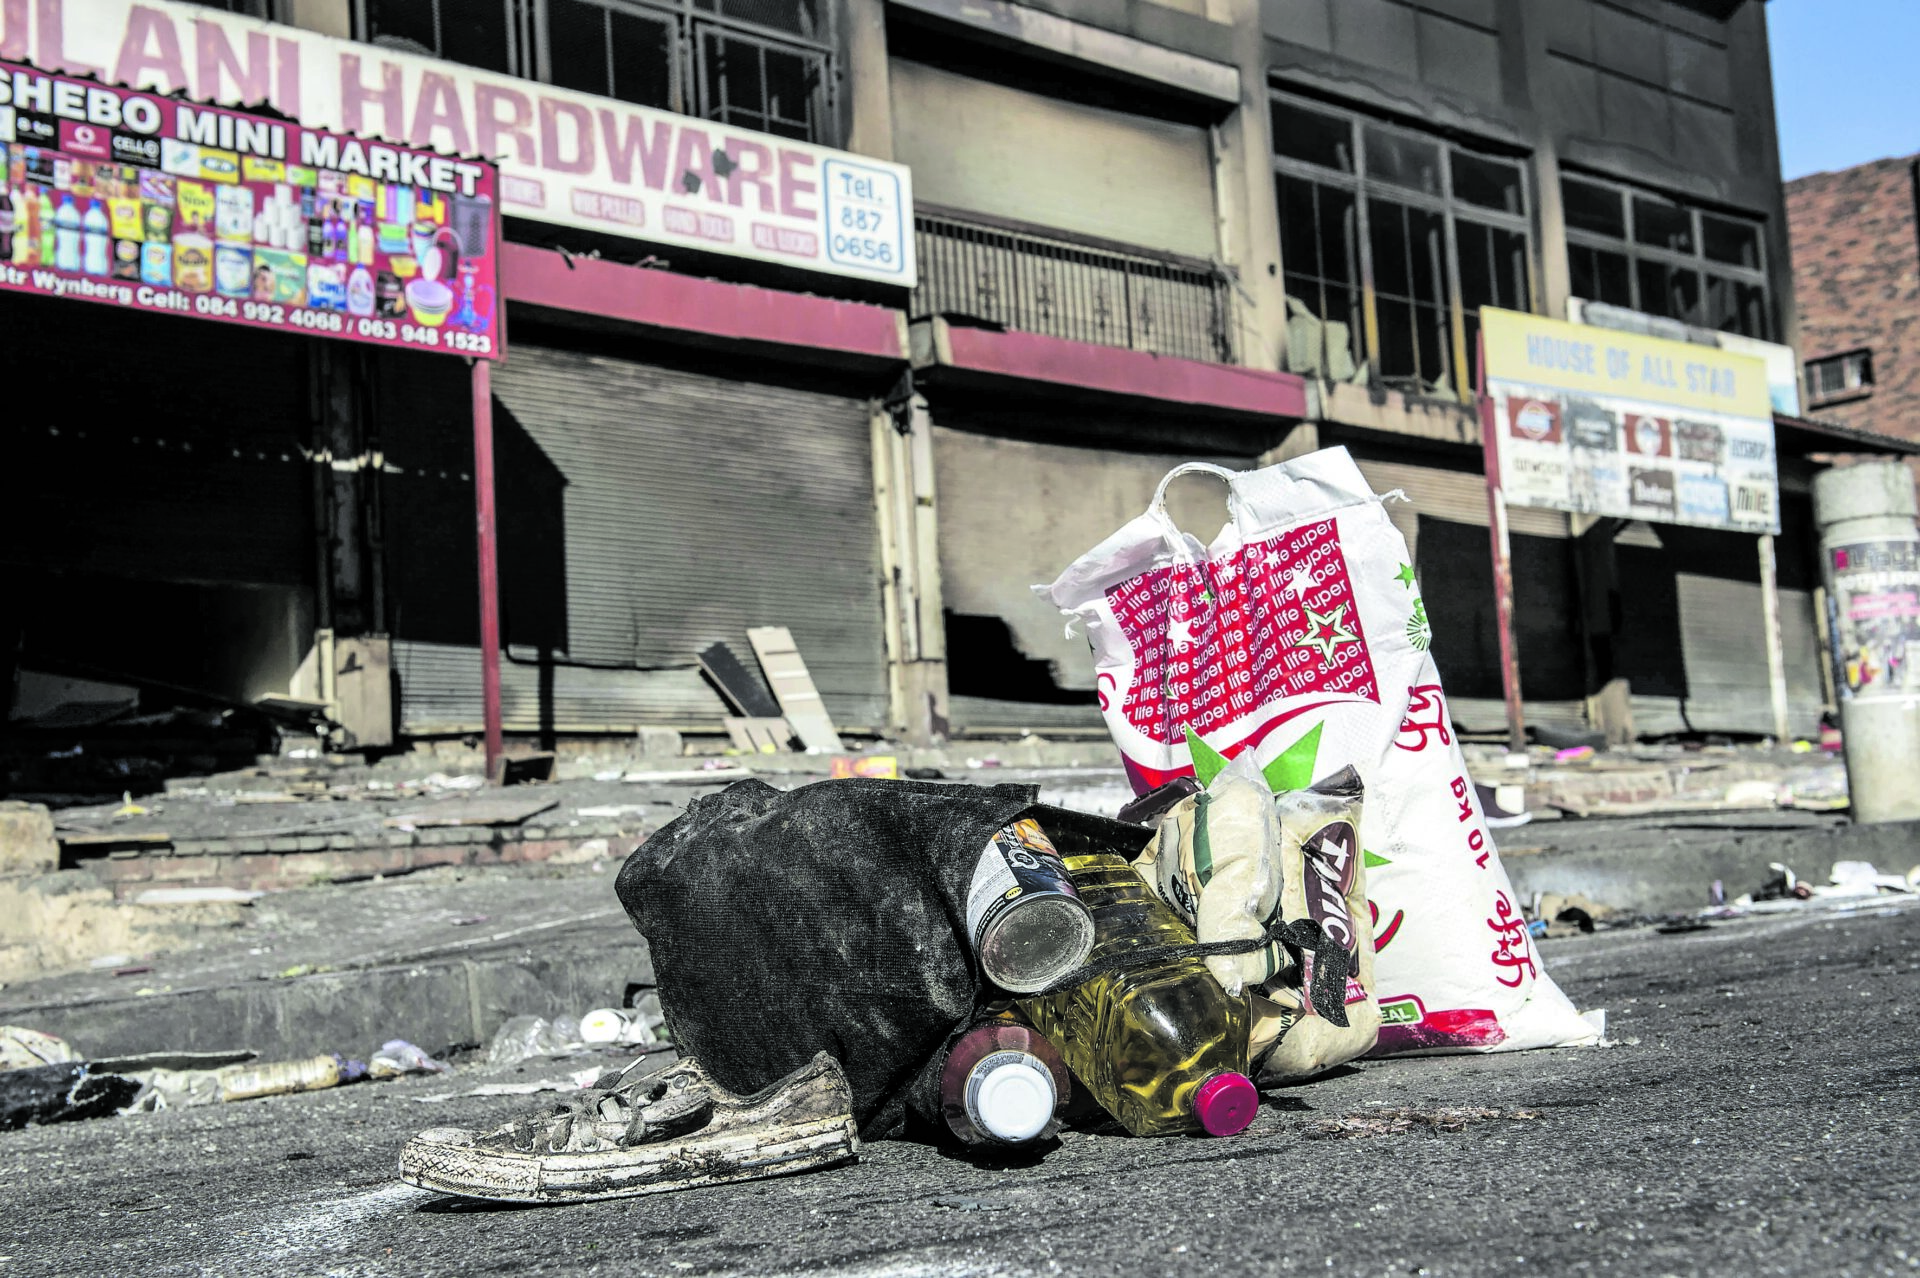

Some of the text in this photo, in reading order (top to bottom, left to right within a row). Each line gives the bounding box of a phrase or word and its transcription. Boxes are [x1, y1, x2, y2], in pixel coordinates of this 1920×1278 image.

[0, 68, 161, 135] HEBO
[176, 104, 286, 160] MINI
[300, 131, 482, 198] MARKET
[338, 52, 817, 221] HARDWARE
[840, 172, 882, 202] Tel.
[834, 235, 891, 263] 0656
[842, 207, 881, 232] 887
[32, 270, 133, 305] Wynberg
[195, 295, 237, 317] 084
[243, 301, 284, 324] 992
[1526, 333, 1737, 398] HOUSE OF ALL STAR
[1219, 589, 1236, 608] life
[1290, 519, 1333, 553] super
[1127, 590, 1150, 610] life
[1135, 608, 1155, 625] life
[1193, 620, 1218, 649] super
[1219, 609, 1240, 628] life
[1269, 568, 1293, 589] life
[1294, 538, 1337, 573] super
[1134, 705, 1154, 721] life
[1192, 661, 1223, 690] super
[1225, 649, 1247, 669] life
[1249, 622, 1274, 655] super
[1274, 608, 1299, 629] life
[1301, 579, 1347, 610] super
[1140, 686, 1158, 702] life
[1192, 641, 1220, 669] super
[1222, 629, 1244, 648] life
[1271, 589, 1295, 609] life
[1142, 627, 1157, 644] life
[1169, 702, 1189, 720] life
[1192, 681, 1225, 709] super
[1227, 670, 1250, 690] life
[1251, 642, 1278, 675] super
[1278, 629, 1304, 650] life
[1191, 702, 1228, 730] super
[1230, 690, 1253, 710] life
[1254, 663, 1283, 696] super
[1283, 650, 1310, 670] life
[1289, 670, 1316, 691] life
[1318, 640, 1363, 675] super
[1323, 660, 1369, 692] super
[1450, 776, 1490, 870] 10 kg
[1380, 1007, 1412, 1023] EAL
